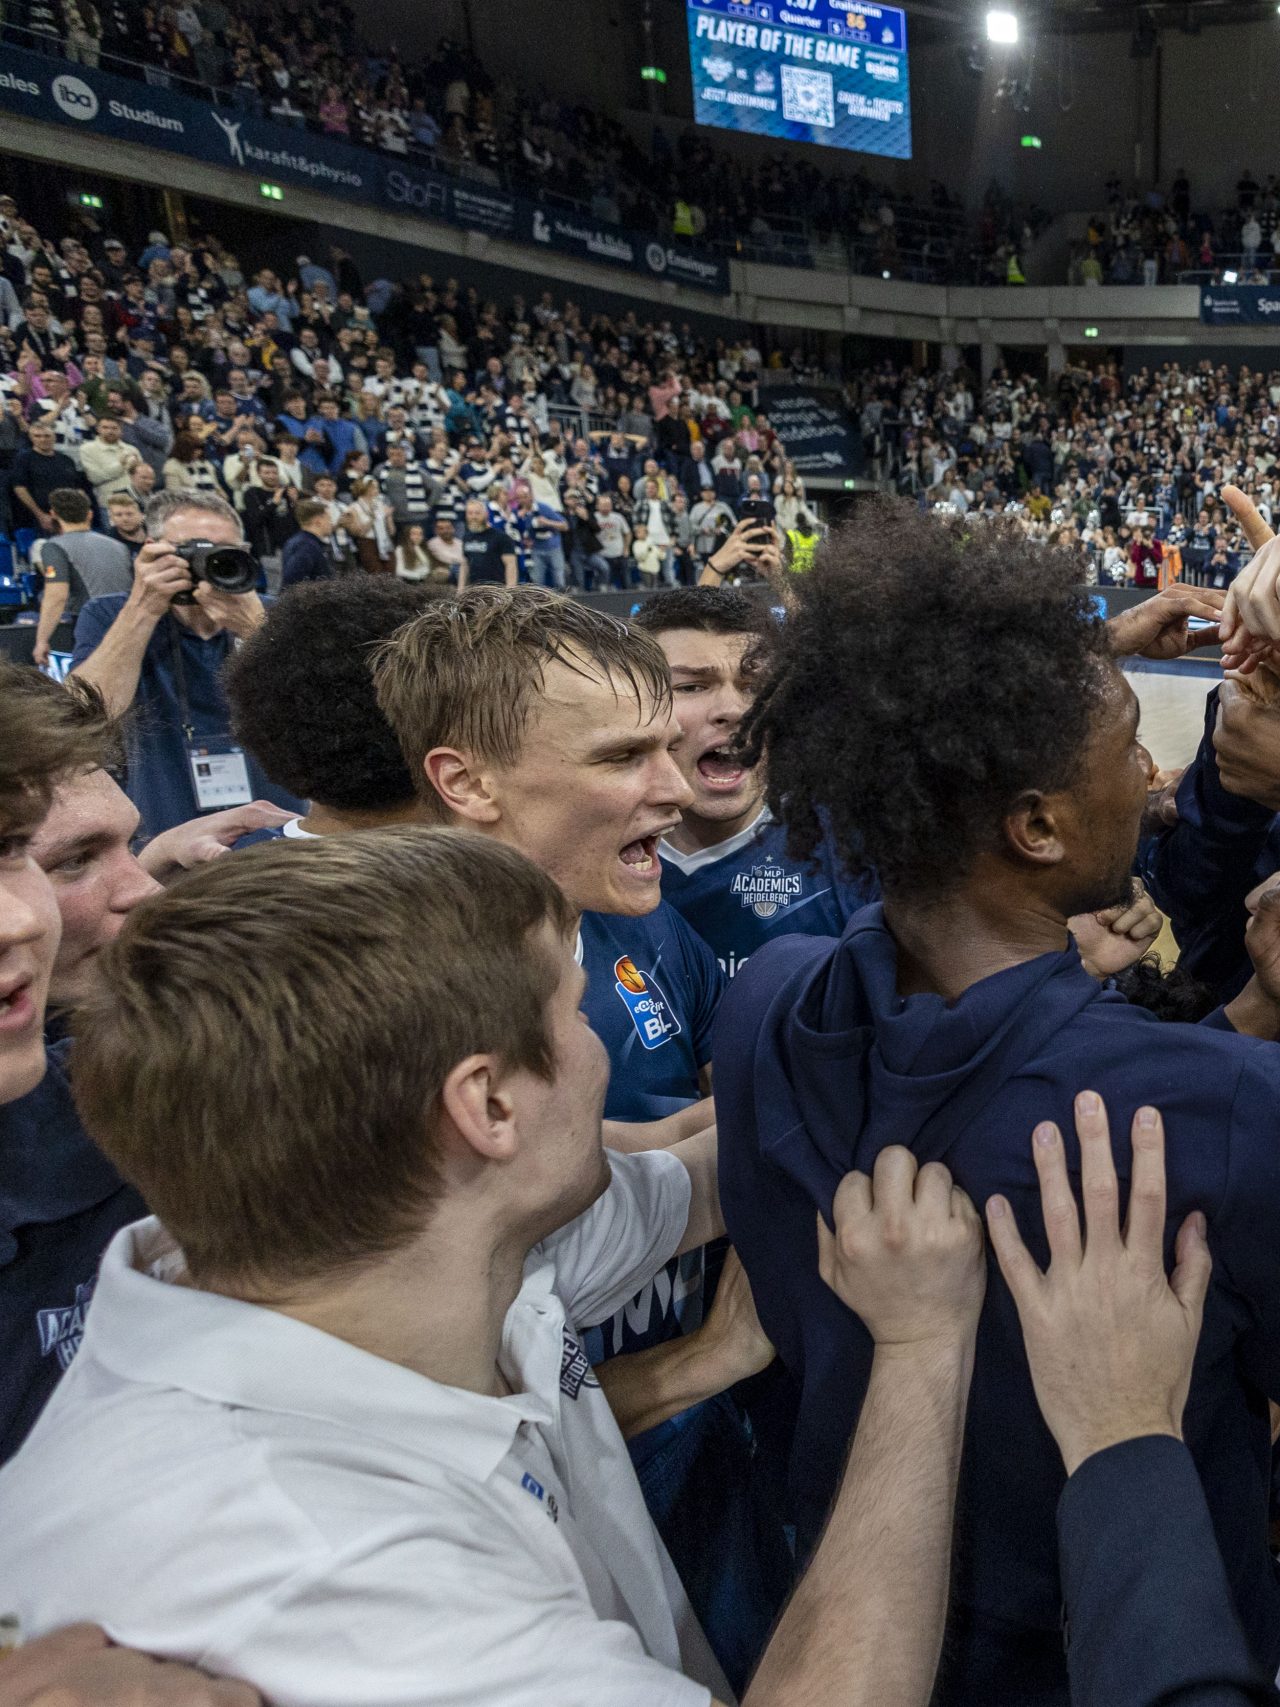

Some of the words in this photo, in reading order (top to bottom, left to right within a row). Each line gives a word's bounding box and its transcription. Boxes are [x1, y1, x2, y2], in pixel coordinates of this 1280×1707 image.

[696, 14, 758, 48] PLAYER
[760, 28, 782, 53] OF
[784, 33, 815, 60] THE
[815, 40, 861, 69] GAME
[108, 100, 184, 133] Studium
[732, 873, 800, 893] ACADEMICS
[764, 869, 782, 878] MLP
[743, 892, 789, 905] HEIDELBERG
